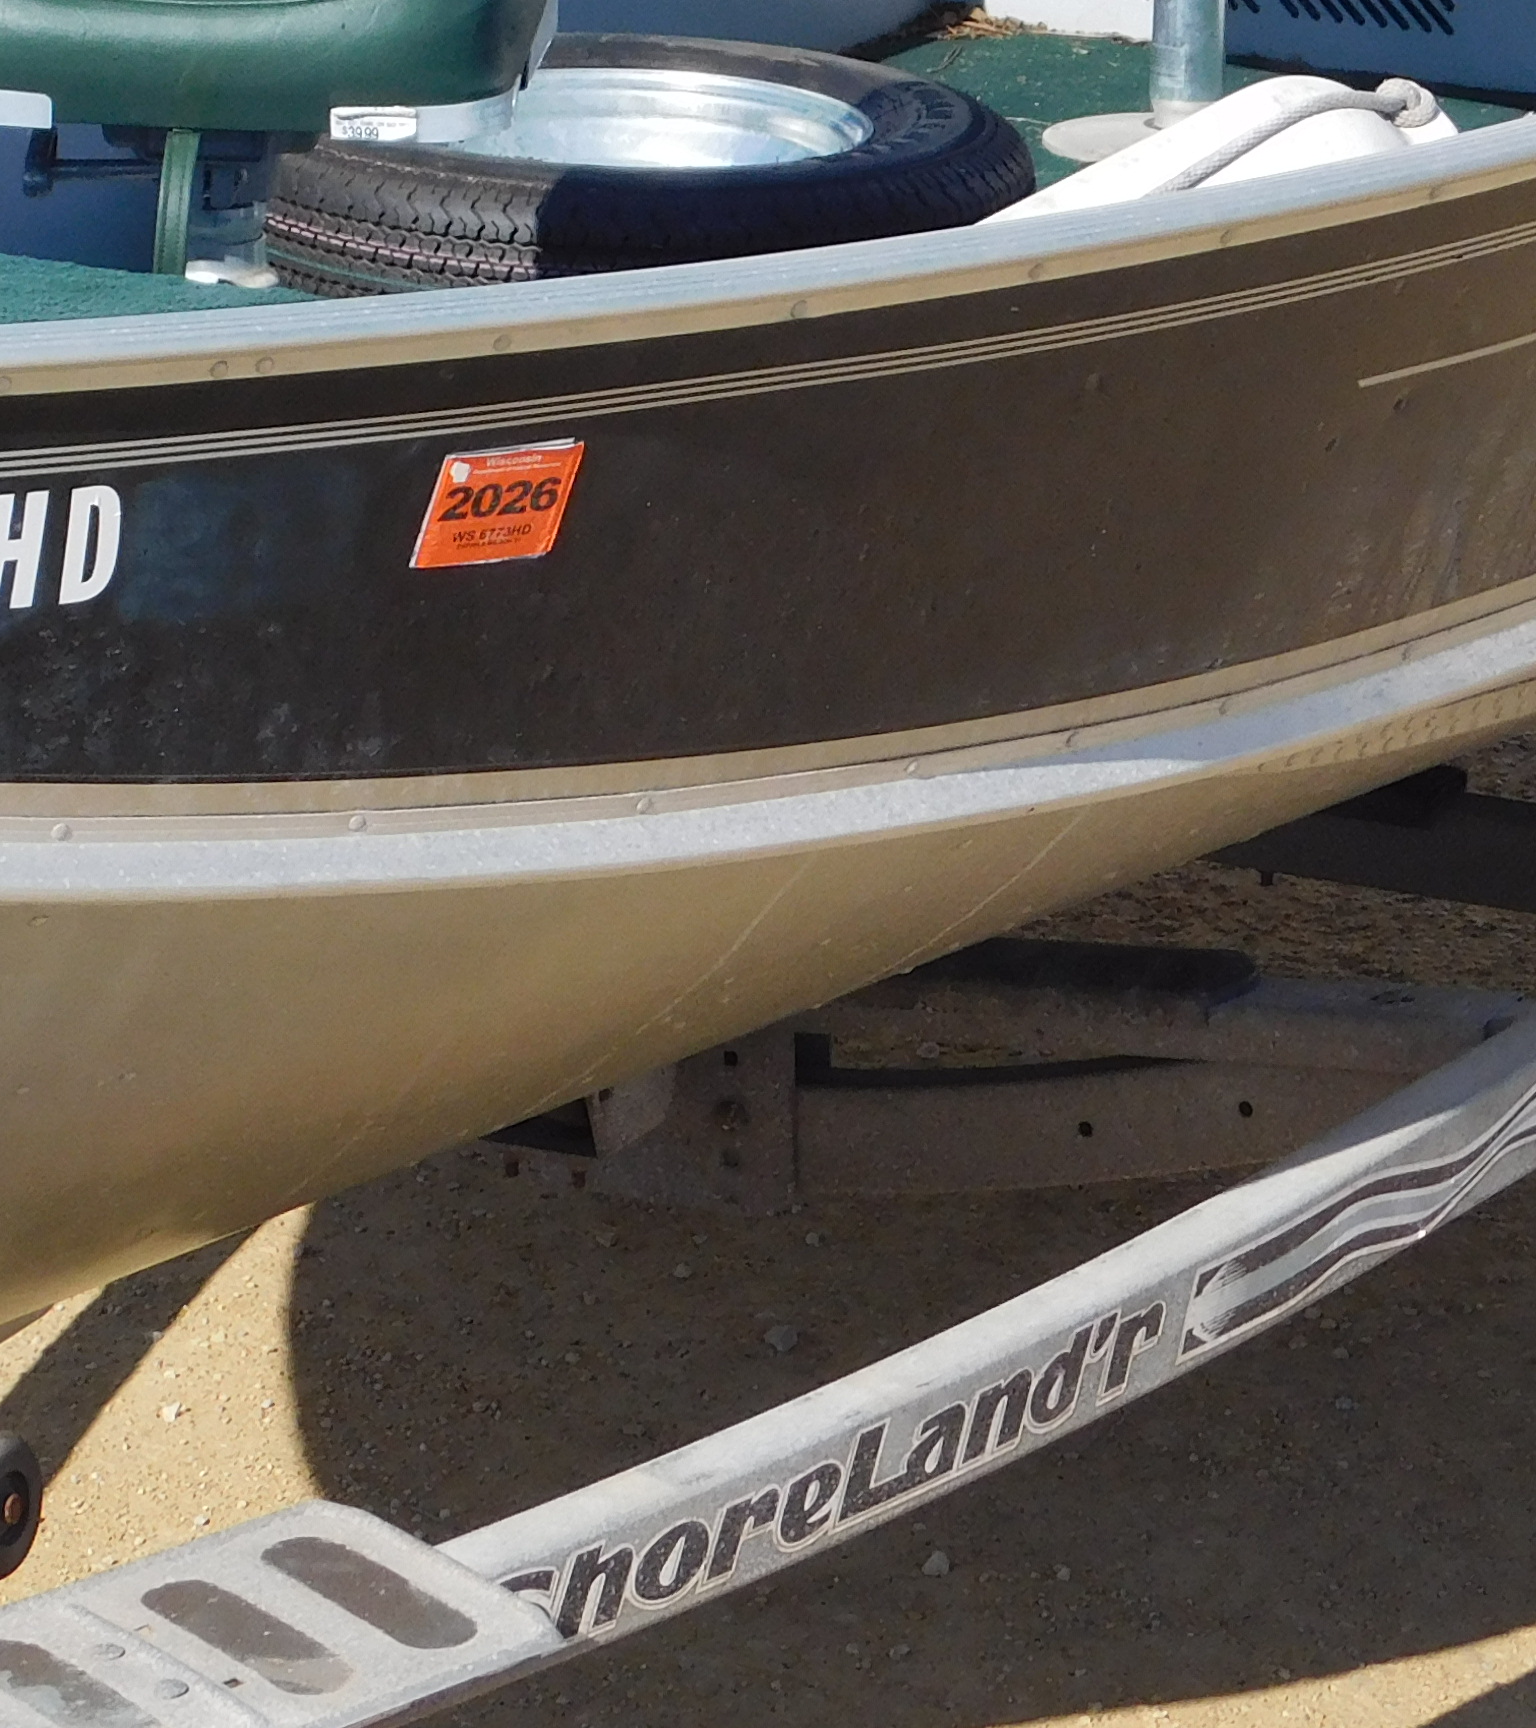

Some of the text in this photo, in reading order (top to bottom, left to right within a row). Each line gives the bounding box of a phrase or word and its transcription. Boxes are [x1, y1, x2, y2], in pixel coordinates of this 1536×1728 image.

[486, 454, 544, 467] Wisconsin
[437, 476, 562, 522] 2026
[452, 530, 475, 543] WS
